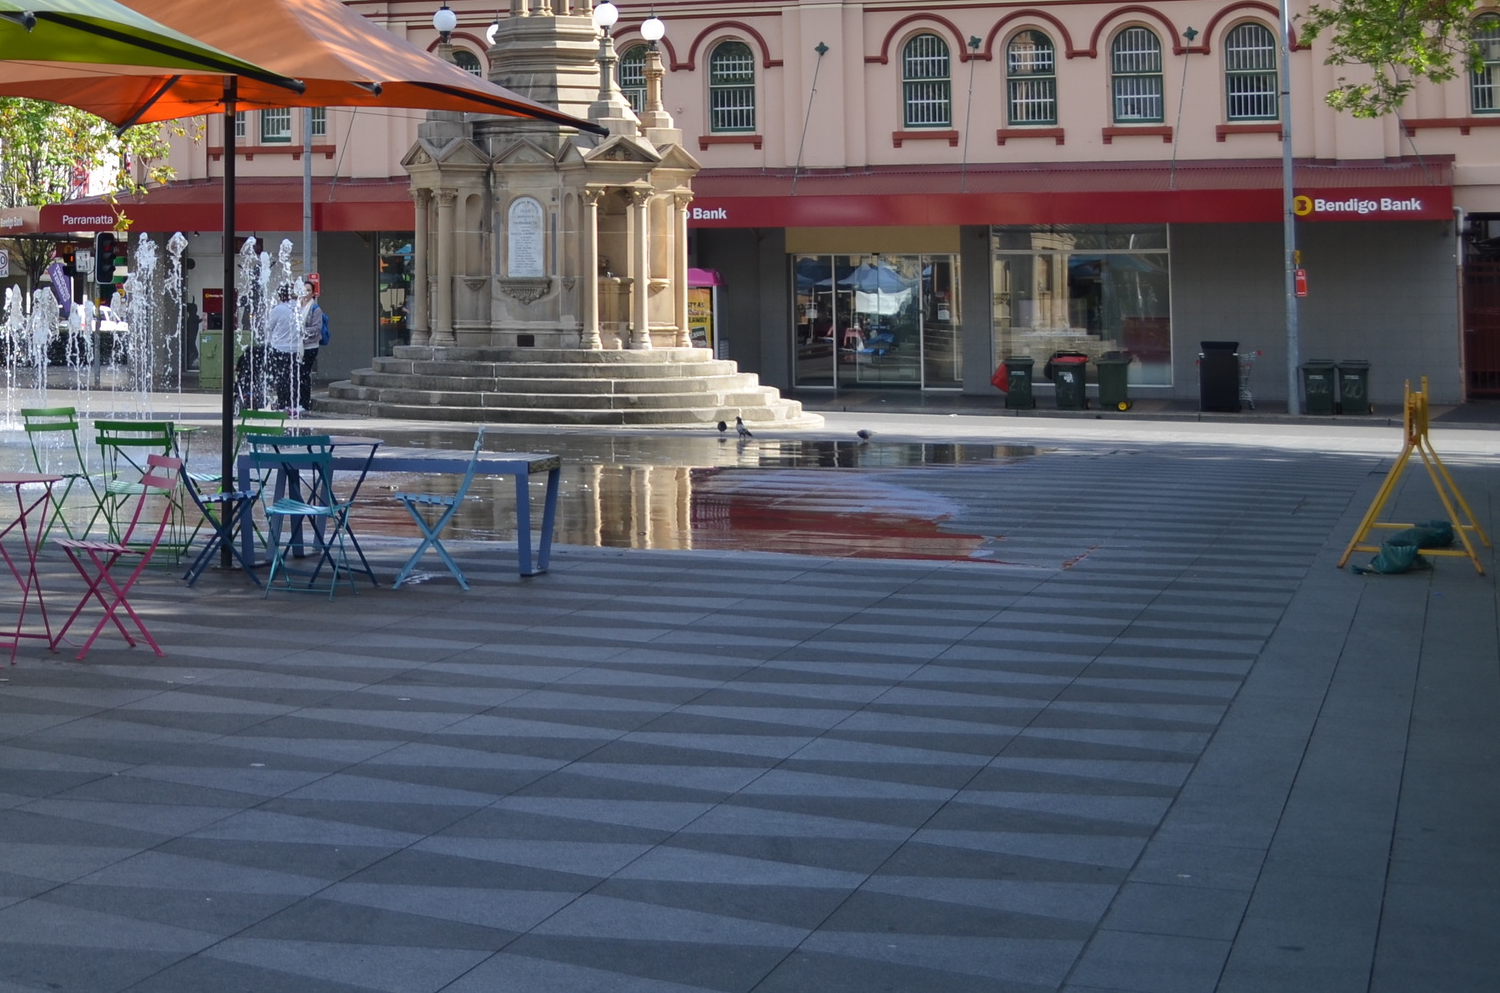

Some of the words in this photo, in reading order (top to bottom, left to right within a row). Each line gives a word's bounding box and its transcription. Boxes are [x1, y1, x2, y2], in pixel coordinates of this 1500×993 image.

[1314, 198, 1378, 214] Bendigo
[1380, 198, 1422, 211] Bank
[62, 214, 113, 225] Parramatta
[693, 208, 727, 220] Bank
